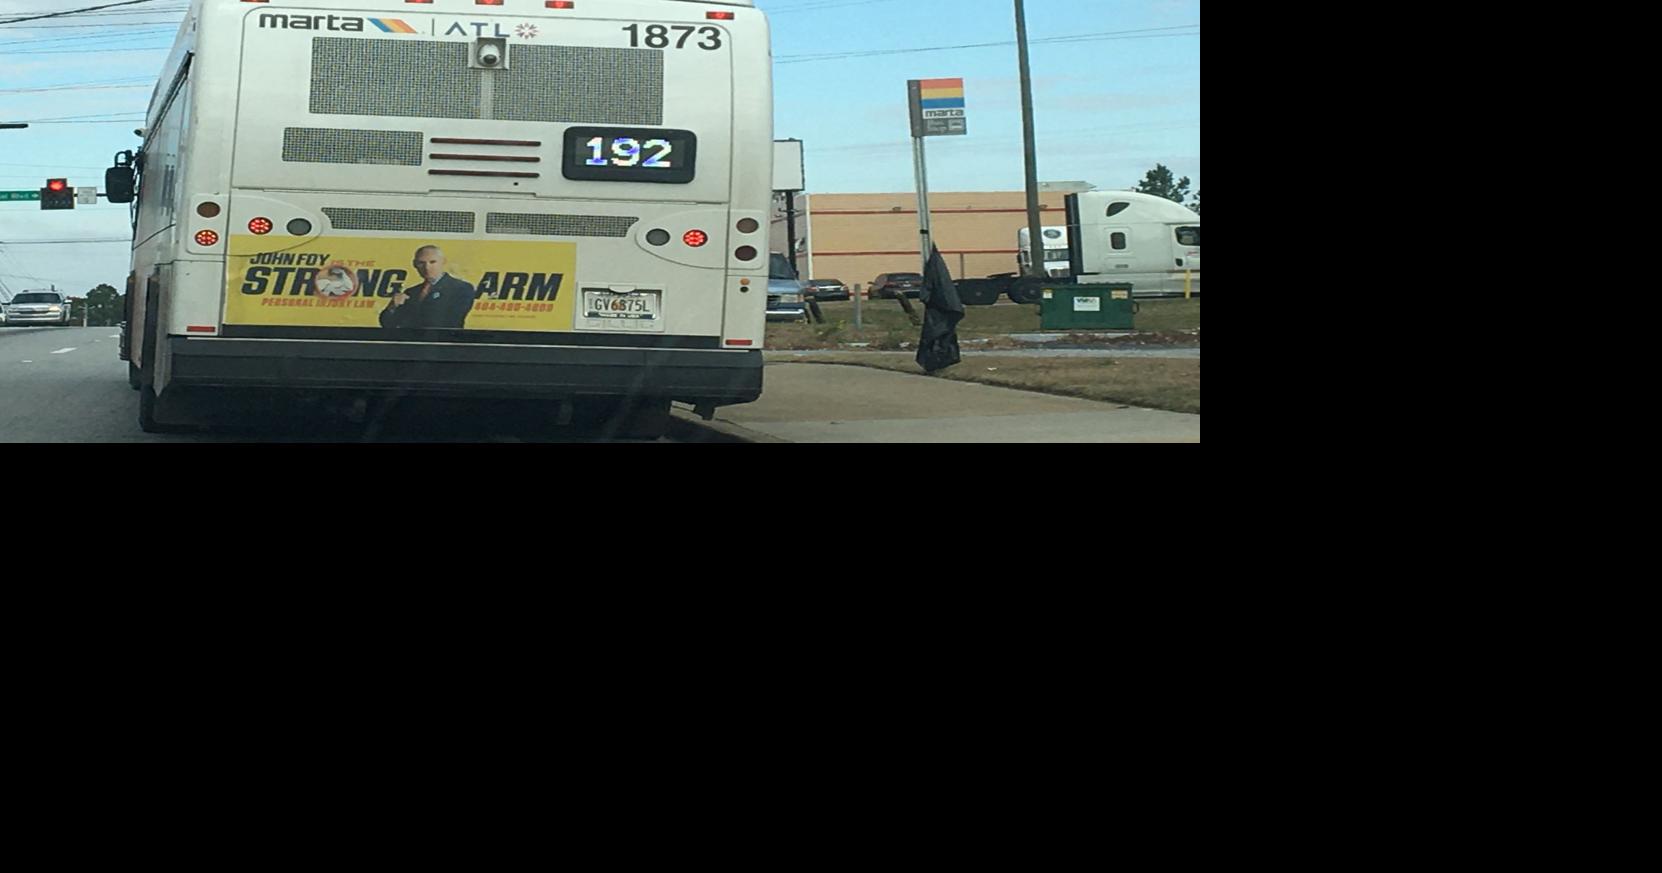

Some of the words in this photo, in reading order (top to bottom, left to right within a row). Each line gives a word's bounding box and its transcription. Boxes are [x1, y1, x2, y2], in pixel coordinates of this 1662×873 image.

[258, 13, 364, 32] marta
[445, 22, 510, 38] ATL
[621, 23, 722, 51] 1873
[925, 109, 964, 118] marta
[585, 136, 672, 168] 192
[250, 252, 296, 265] JOHN
[296, 253, 330, 266] FOY
[475, 271, 564, 301] ARM
[261, 297, 313, 308] PERSONAL
